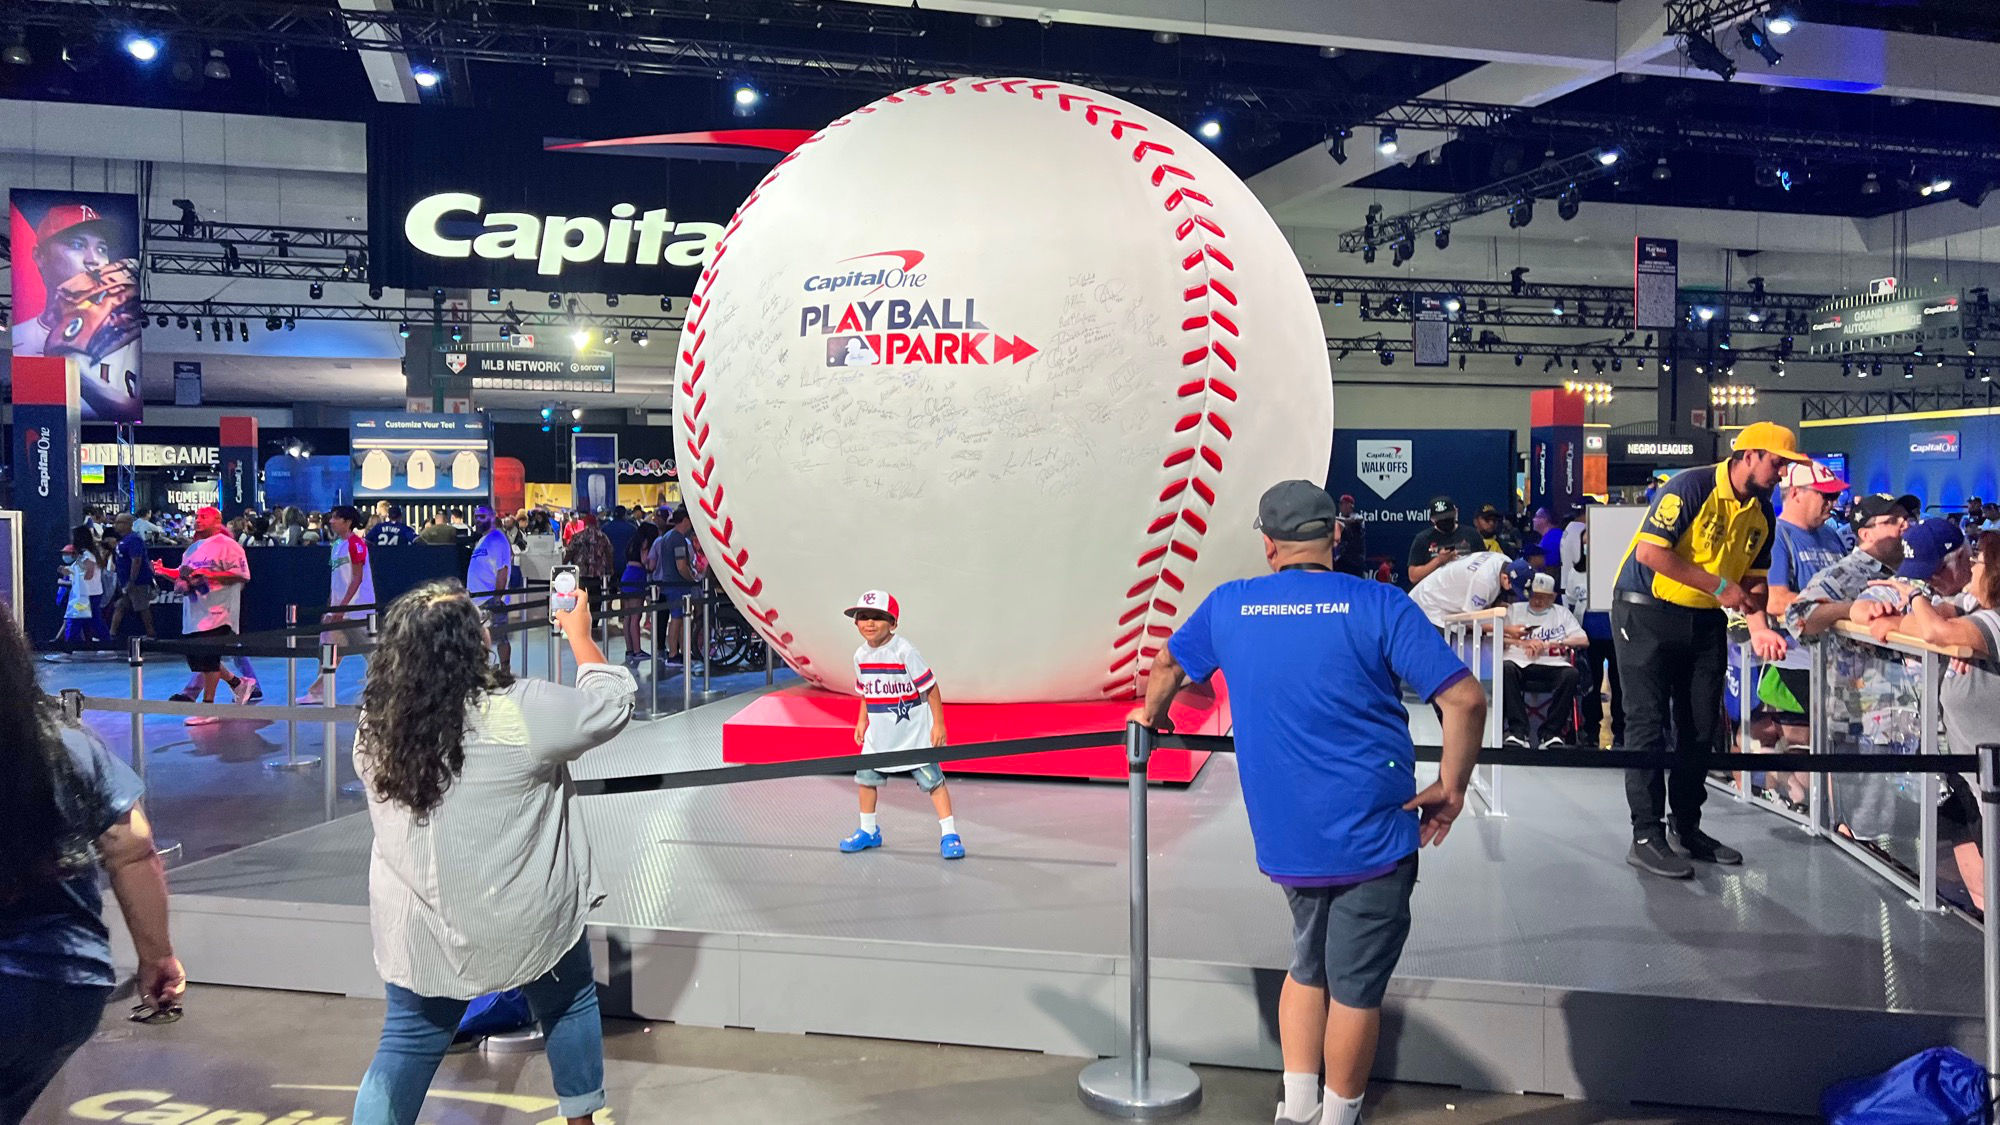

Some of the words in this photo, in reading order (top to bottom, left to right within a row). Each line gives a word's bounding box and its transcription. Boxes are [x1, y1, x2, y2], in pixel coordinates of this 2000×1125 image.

[404, 192, 726, 276] Capita
[1854, 307, 1884, 322] GRAND
[886, 332, 990, 365] PARK
[481, 359, 505, 371] MLB
[506, 360, 562, 373] NETWORK
[385, 420, 422, 429] Customize
[423, 421, 439, 429] Your
[161, 446, 220, 464] GAME
[1627, 443, 1656, 455] NEGRO
[1657, 444, 1694, 455] LEAGUES
[1361, 461, 1386, 474] WALK
[1387, 461, 1408, 474] OFFS
[167, 490, 199, 503] HOME
[1381, 510, 1404, 521] One
[1240, 604, 1312, 616] EXPERIENCE
[1315, 602, 1350, 614] TEAM
[875, 678, 913, 695] Covina
